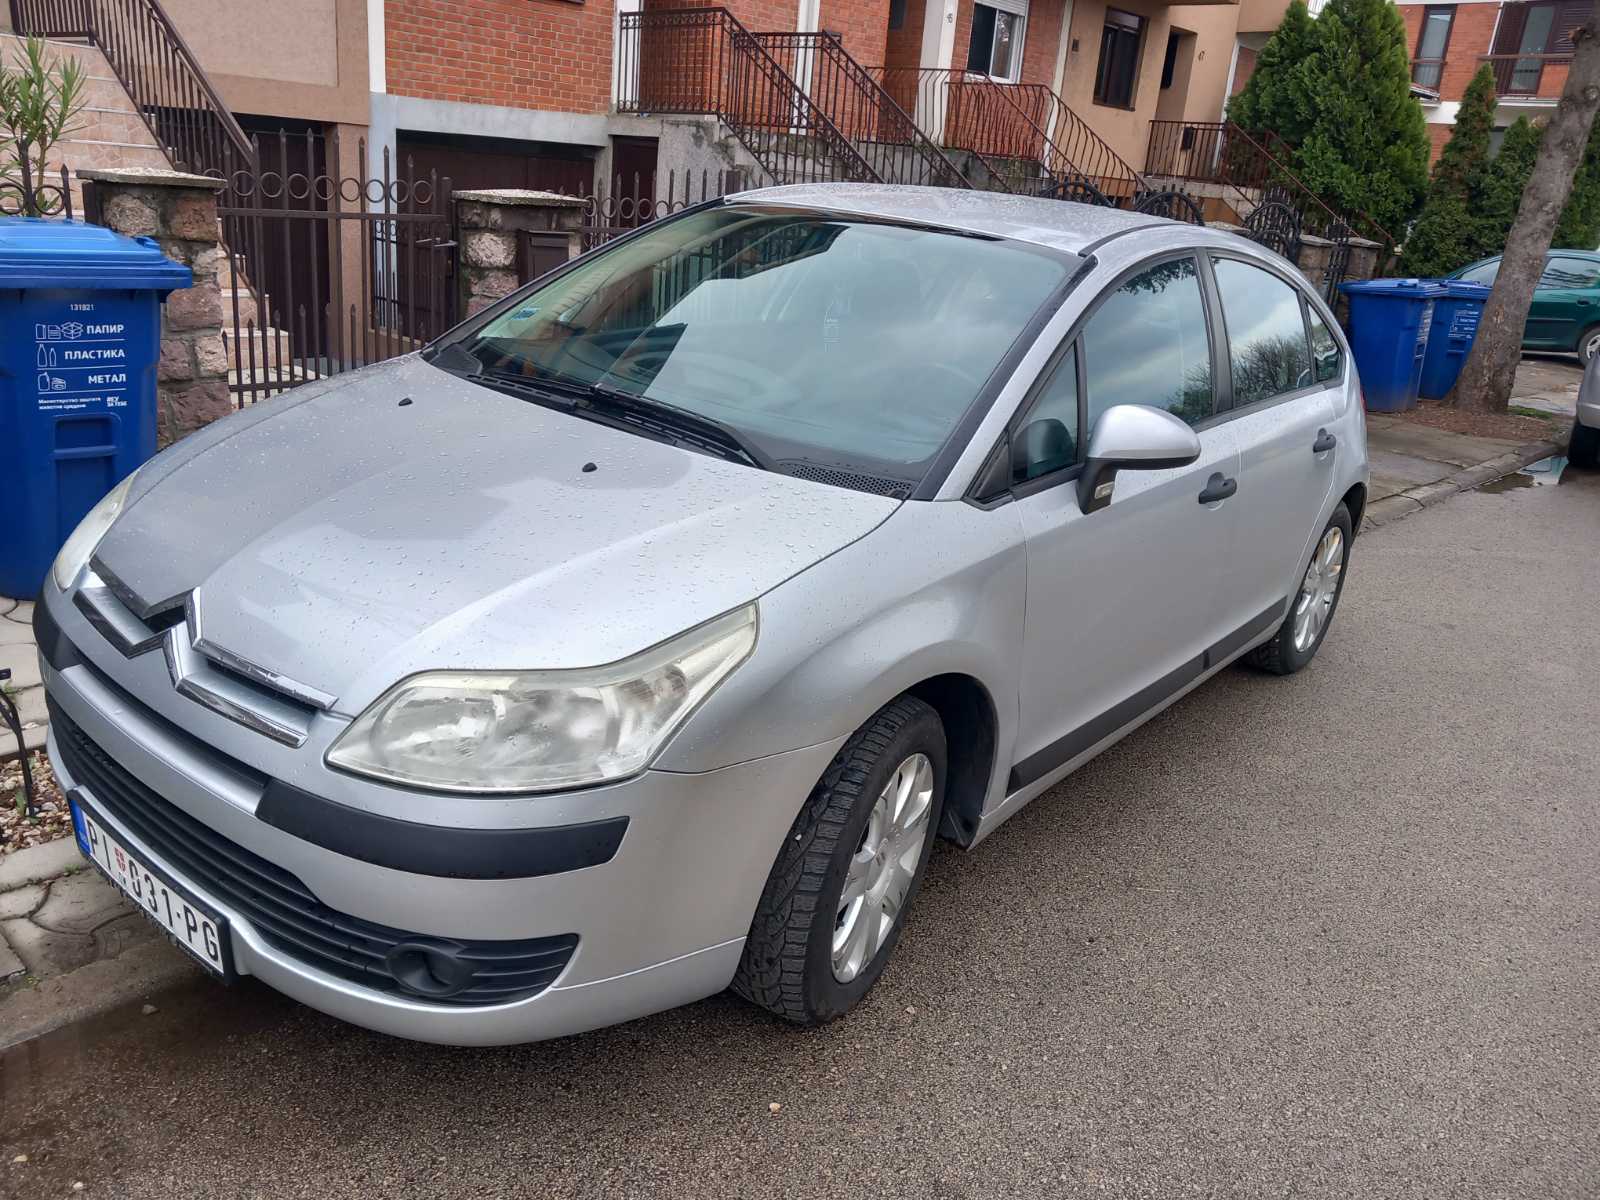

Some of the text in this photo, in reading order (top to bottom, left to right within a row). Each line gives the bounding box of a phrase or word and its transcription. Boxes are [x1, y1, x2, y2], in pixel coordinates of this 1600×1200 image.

[86, 324, 125, 334] ПАПИР
[64, 349, 126, 360] ПЛАСТИКА
[88, 373, 127, 384] МЕТАЛ
[87, 819, 112, 871] PI
